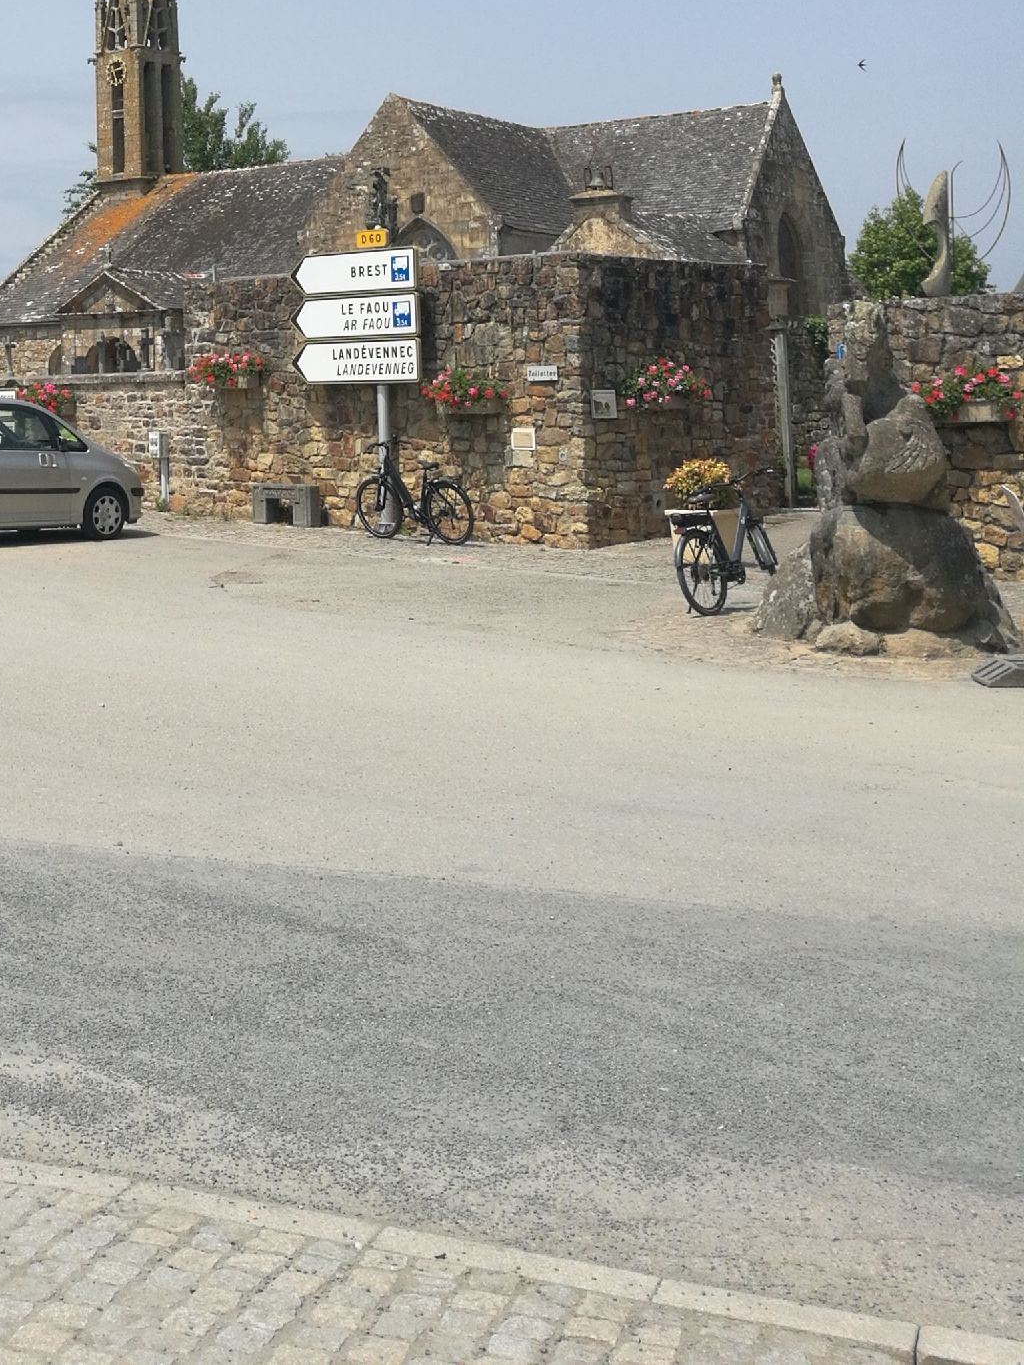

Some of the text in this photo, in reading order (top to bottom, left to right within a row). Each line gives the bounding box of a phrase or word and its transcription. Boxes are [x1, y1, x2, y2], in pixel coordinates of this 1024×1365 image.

[350, 264, 387, 278] BREST
[341, 301, 389, 315] LE FAOU
[343, 317, 391, 330] AR FAOU
[332, 344, 413, 361] LANDÉVENNEC
[336, 362, 415, 376] LANDEVENNEG
